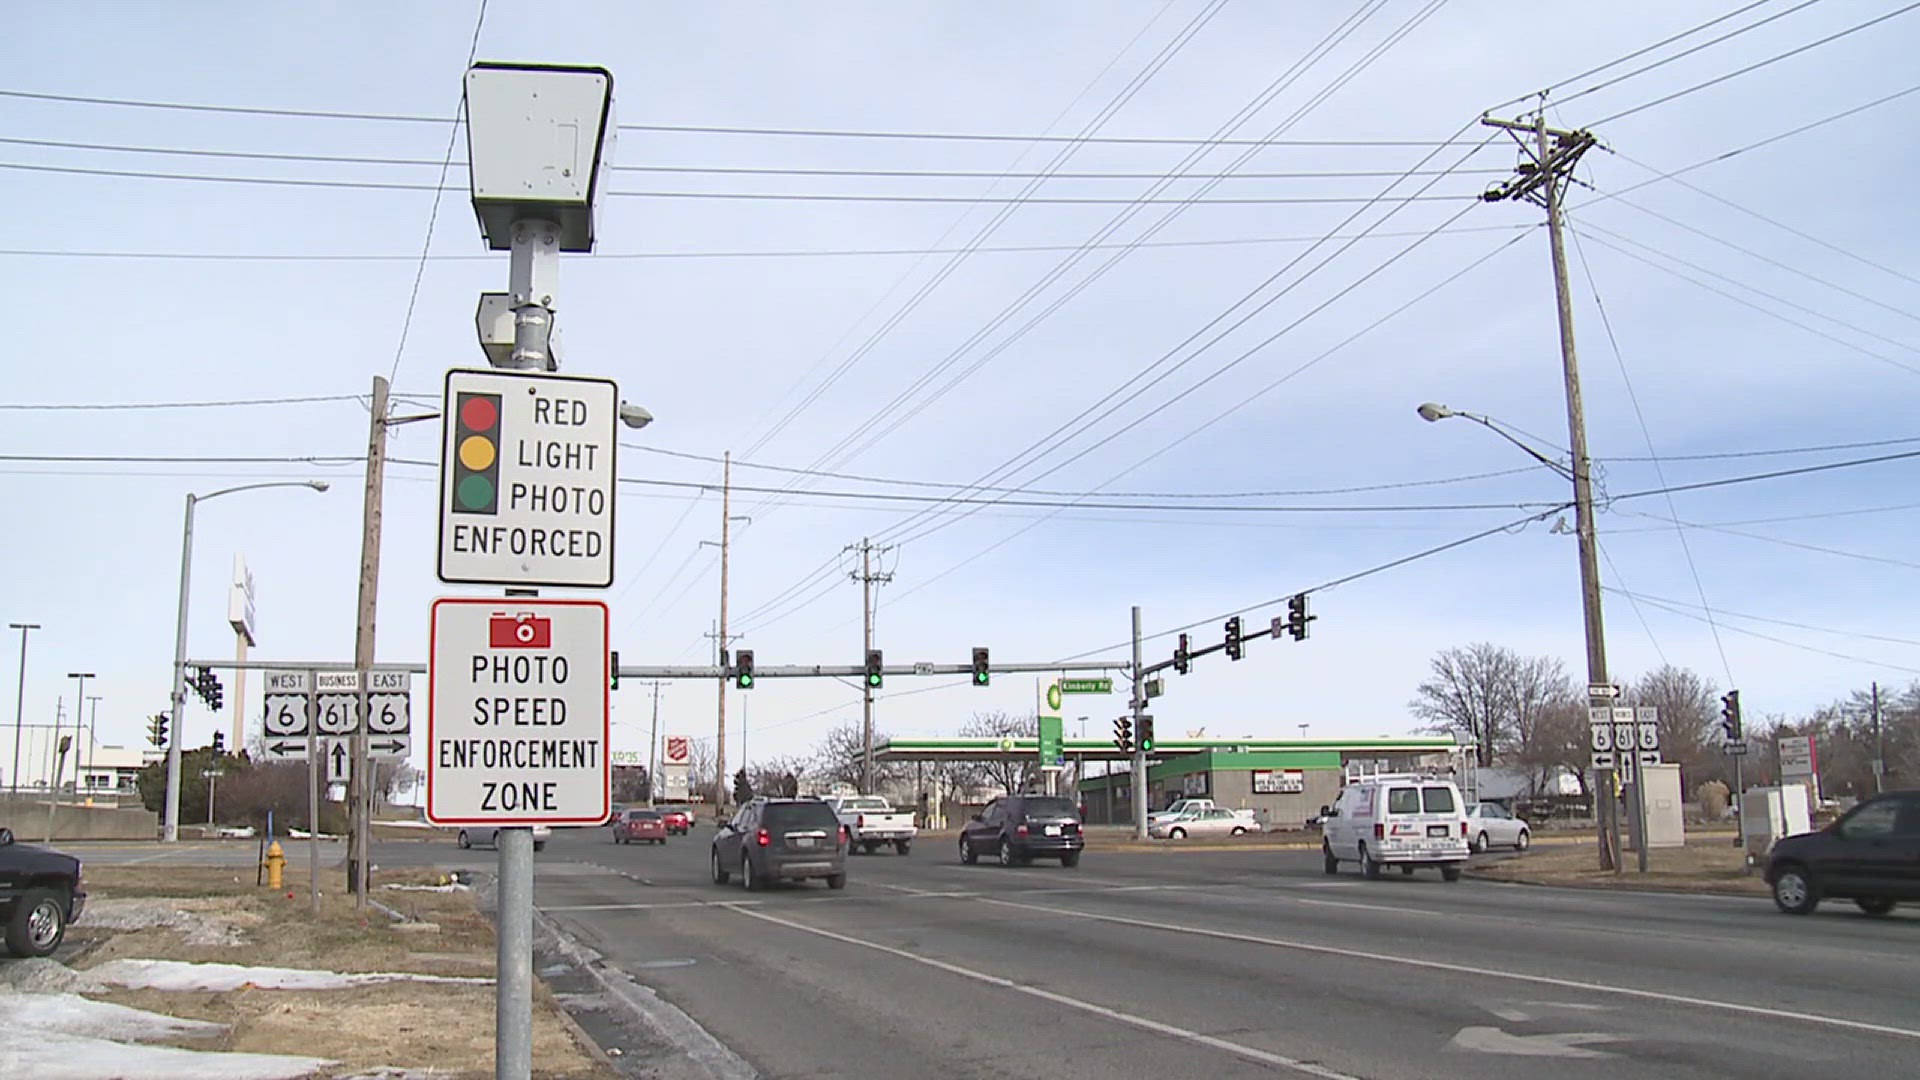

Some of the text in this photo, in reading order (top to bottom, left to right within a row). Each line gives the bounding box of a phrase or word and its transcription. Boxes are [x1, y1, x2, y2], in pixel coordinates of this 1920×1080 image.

[534, 397, 587, 426] RED
[518, 439, 599, 471] LIGHT
[510, 483, 605, 516] PHOTO
[453, 524, 602, 558] ENFORCED
[270, 674, 304, 688] WEST
[319, 675, 357, 687] BUSINESS
[373, 673, 404, 687] EAST
[472, 655, 569, 684] PHOTO
[279, 703, 295, 727] 6
[325, 703, 348, 726] 61
[381, 702, 396, 726] 6
[473, 697, 567, 726] SPEED
[1597, 730, 1606, 747] 6
[1618, 729, 1631, 746] 61
[1644, 729, 1653, 745] 6
[439, 739, 599, 769] ENFORCEMENT
[481, 782, 558, 812] ZONE
